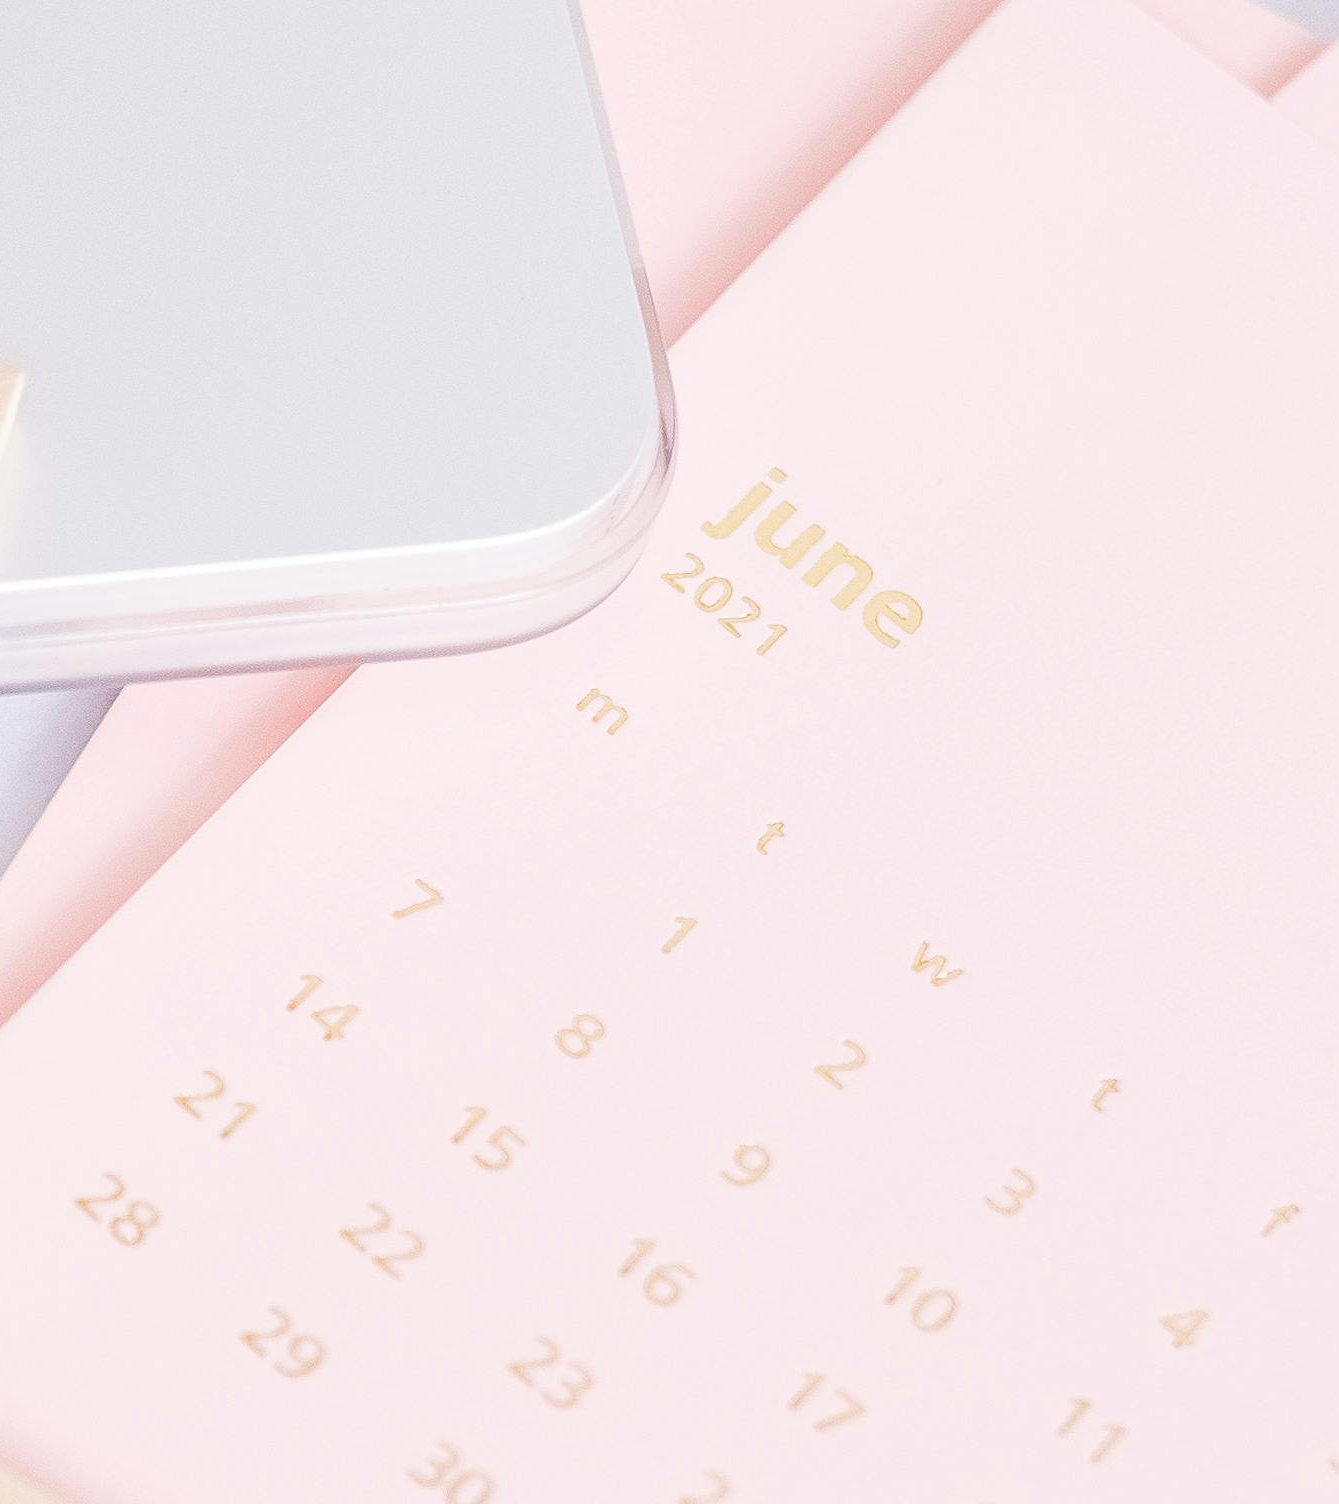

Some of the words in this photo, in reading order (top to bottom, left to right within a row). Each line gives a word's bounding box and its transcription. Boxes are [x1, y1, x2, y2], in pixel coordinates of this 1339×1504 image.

[659, 550, 791, 658] 2021
[696, 462, 929, 652] june
[74, 1173, 162, 1248] 28
[239, 1309, 327, 1379] 29
[172, 1070, 257, 1140] 21
[338, 1204, 426, 1275] 22
[506, 1338, 594, 1410] 23
[284, 973, 362, 1044] 14
[450, 1104, 529, 1174] 15
[617, 1237, 692, 1308] 16
[787, 1370, 869, 1434] 17
[390, 877, 445, 922] 7
[553, 1011, 608, 1061] 8
[718, 1142, 775, 1188] 9
[884, 1264, 958, 1333] 10
[1057, 1396, 1128, 1465] 11
[661, 914, 700, 956] 1
[814, 1038, 869, 1089] 2
[985, 1168, 1039, 1218] 3
[1162, 1309, 1209, 1350] 4
